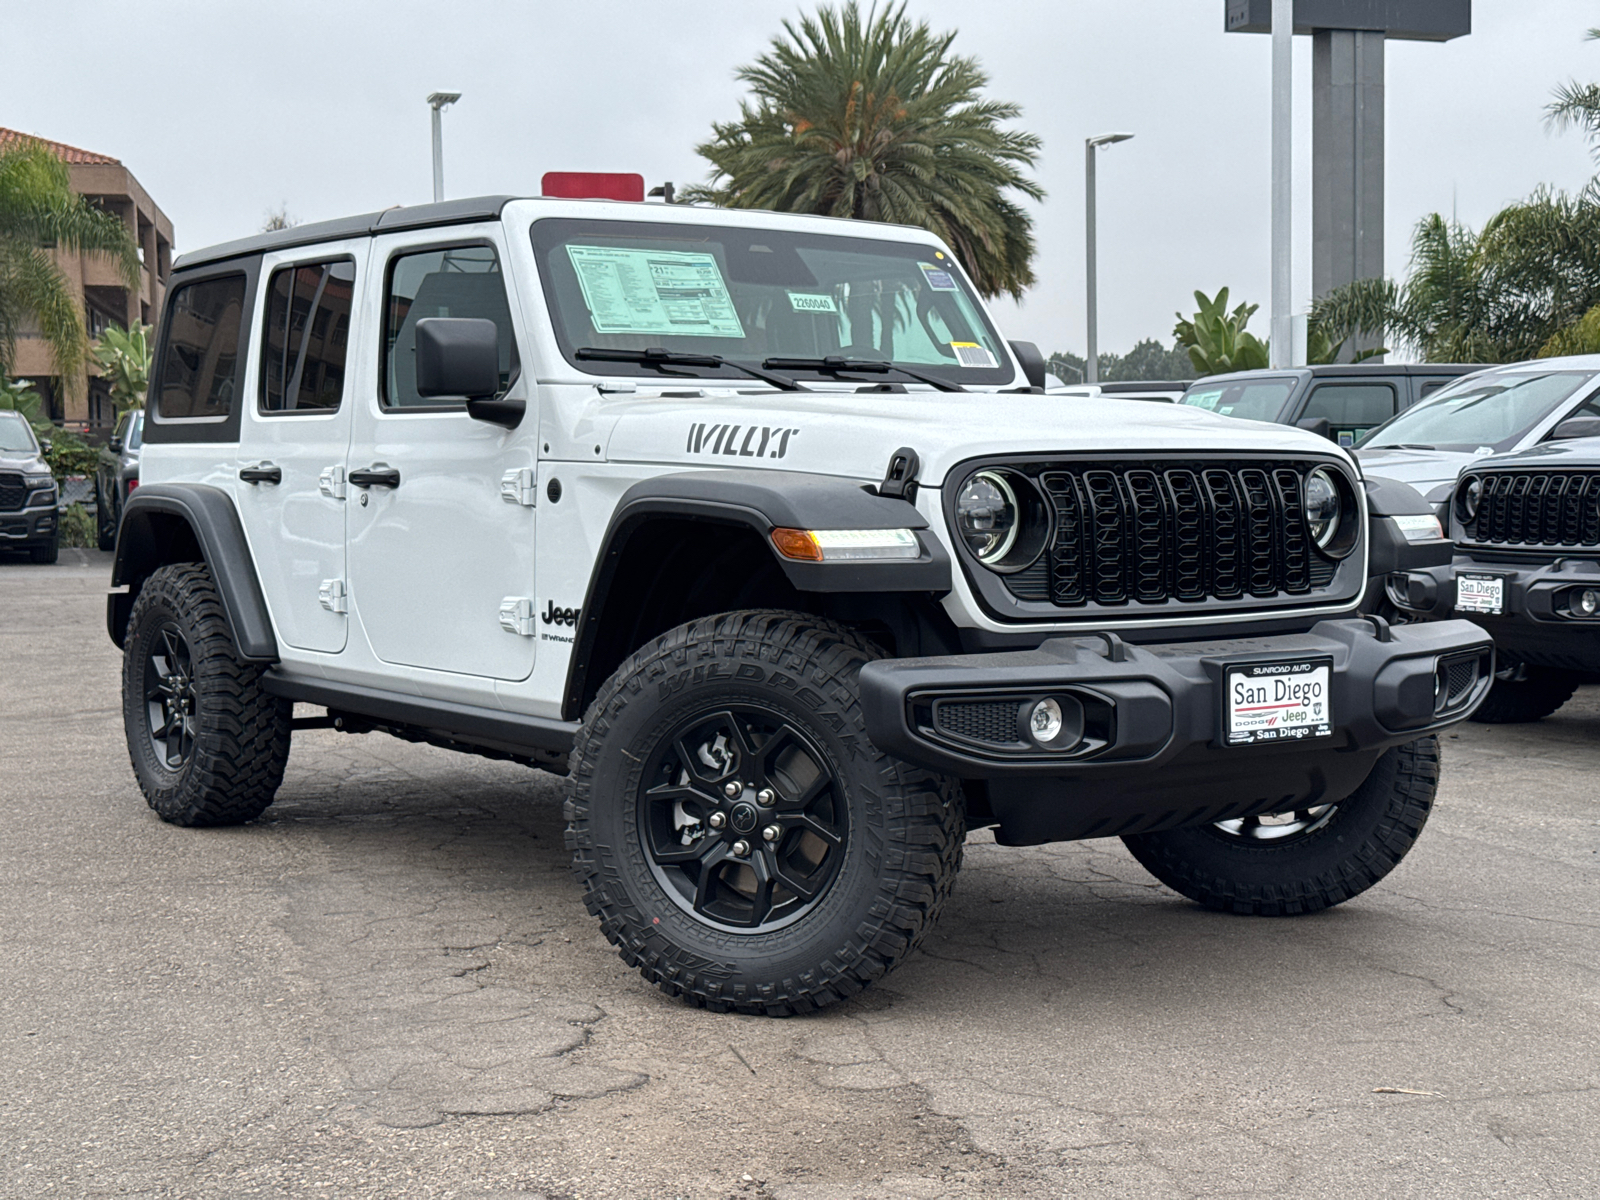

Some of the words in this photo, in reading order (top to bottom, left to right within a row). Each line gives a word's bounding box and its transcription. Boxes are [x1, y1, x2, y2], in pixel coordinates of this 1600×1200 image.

[794, 297, 831, 310] 2260040
[686, 422, 800, 459] WILLYS
[1460, 581, 1475, 592] San
[1476, 582, 1500, 598] Diego
[1253, 665, 1290, 674] SUNROAD
[1291, 663, 1311, 672] AUTO
[1235, 682, 1267, 705] San
[1274, 677, 1322, 707] Diego
[658, 662, 868, 762] WILDPEAK
[1282, 709, 1307, 723] Jeep
[1256, 730, 1277, 739] San
[1279, 727, 1309, 738] Diego
